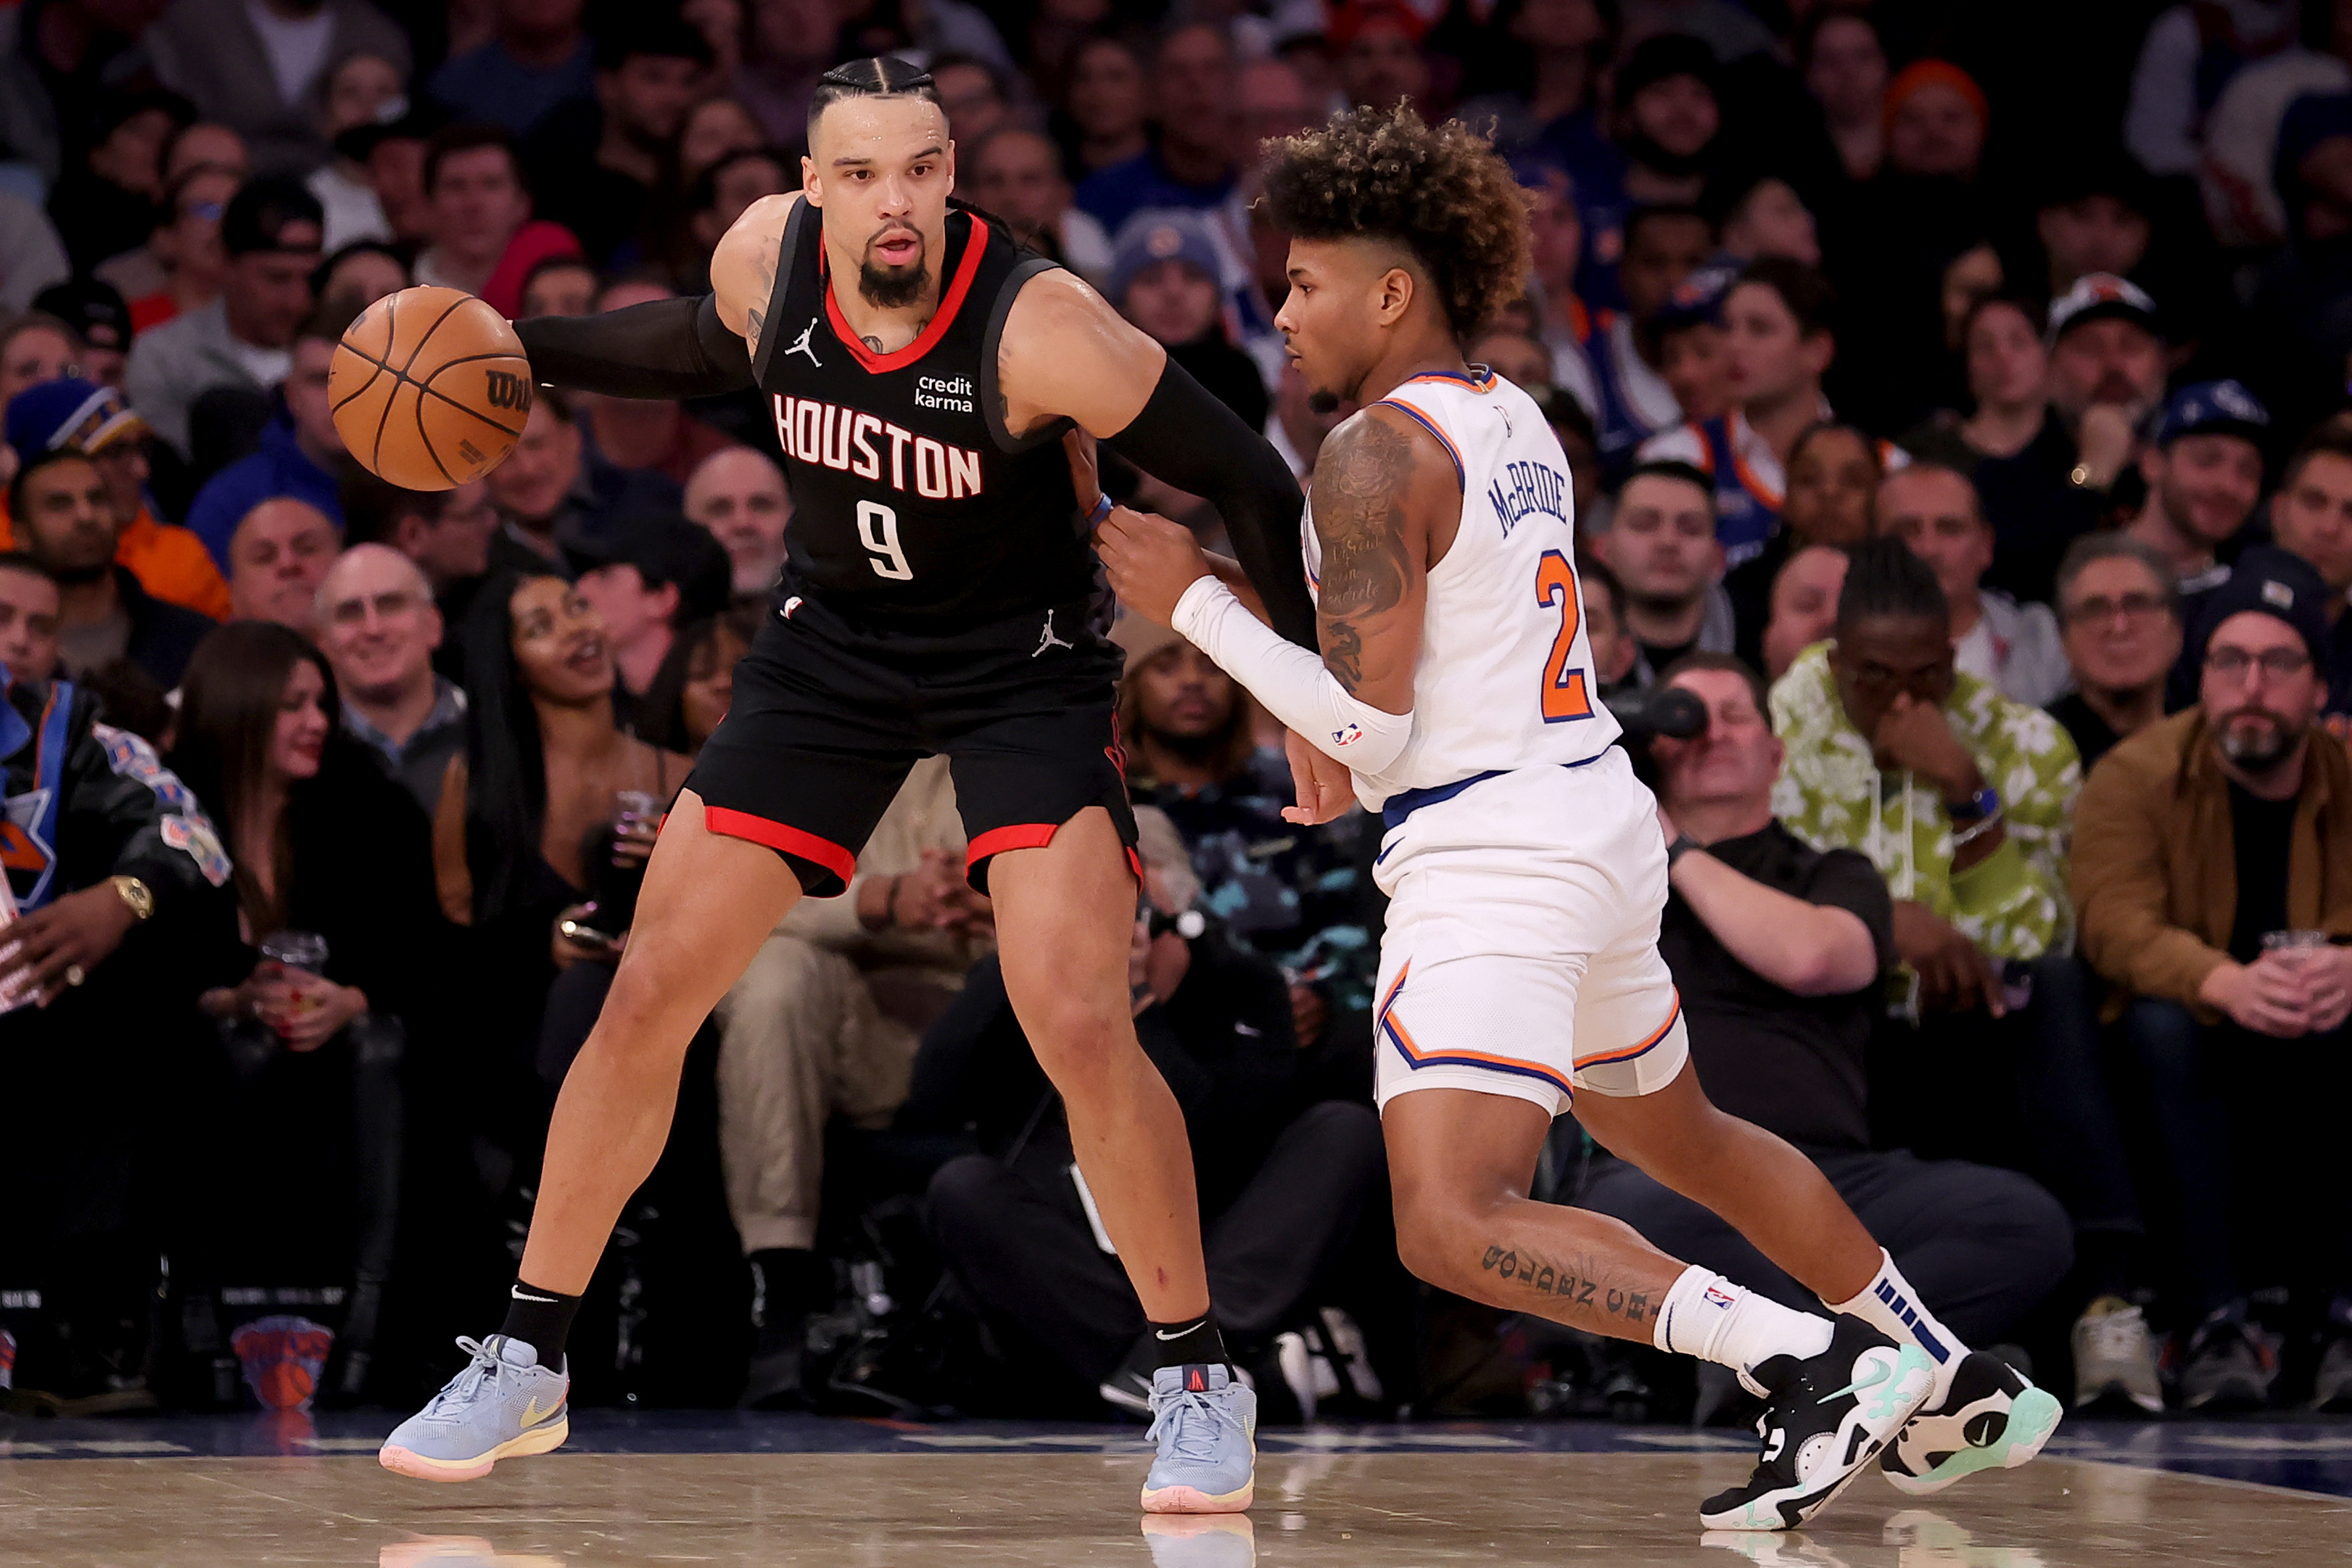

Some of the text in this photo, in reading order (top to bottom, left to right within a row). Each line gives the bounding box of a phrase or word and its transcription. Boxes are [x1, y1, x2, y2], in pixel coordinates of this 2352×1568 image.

[915, 388, 973, 413] karma
[919, 376, 973, 396] credit
[772, 392, 983, 500] HOUSTON
[857, 500, 913, 580] 9
[1487, 461, 1567, 540] McBRIDE
[1535, 548, 1596, 724] 2
[1482, 1245, 1596, 1305] GOLDEN
